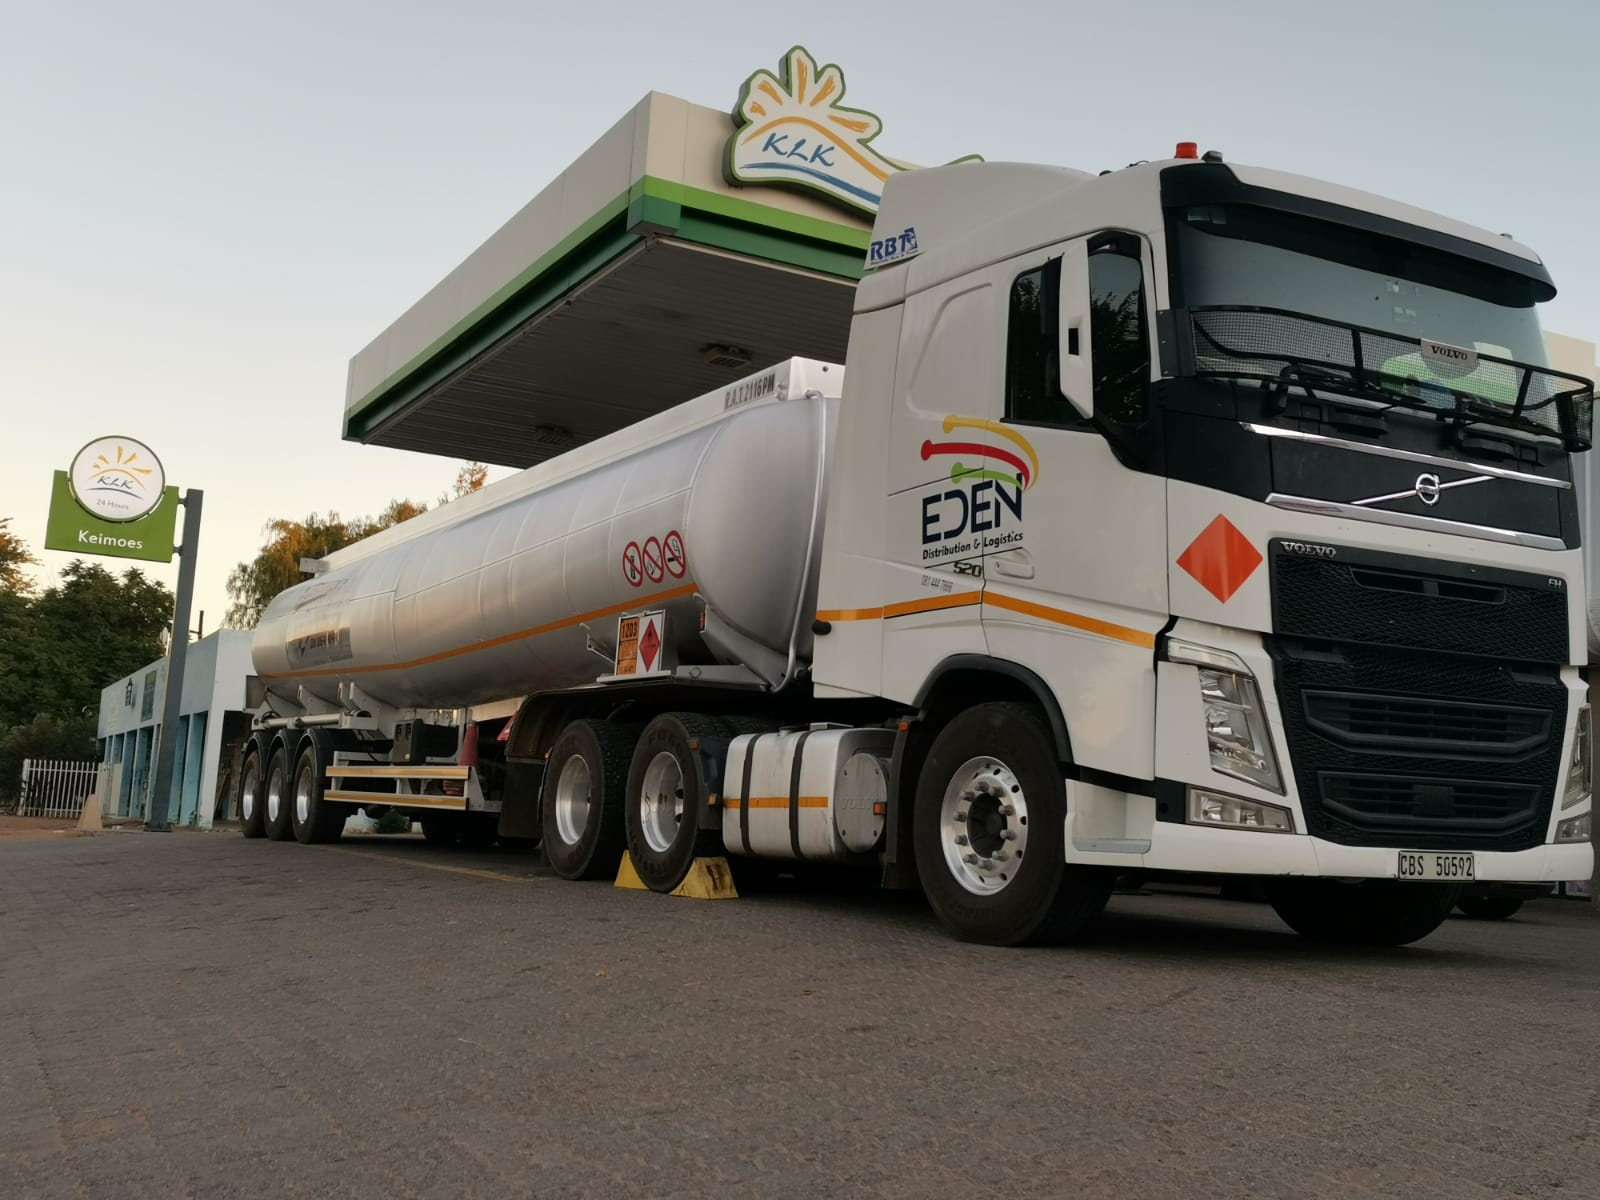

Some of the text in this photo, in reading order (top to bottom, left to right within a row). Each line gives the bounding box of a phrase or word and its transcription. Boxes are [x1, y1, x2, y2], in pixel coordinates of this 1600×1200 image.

[762, 132, 835, 167] KLK
[1431, 345, 1468, 361] VOLVO
[97, 475, 134, 490] KLK
[107, 501, 129, 510] Hours
[922, 472, 1023, 545] EDEN
[78, 529, 143, 549] Keimoes
[922, 530, 1023, 560] Distribution & Logistics
[1280, 541, 1337, 559] VOLVO
[953, 560, 982, 578] 520
[621, 621, 638, 639] 1203
[1400, 855, 1473, 877] CBS 50592
